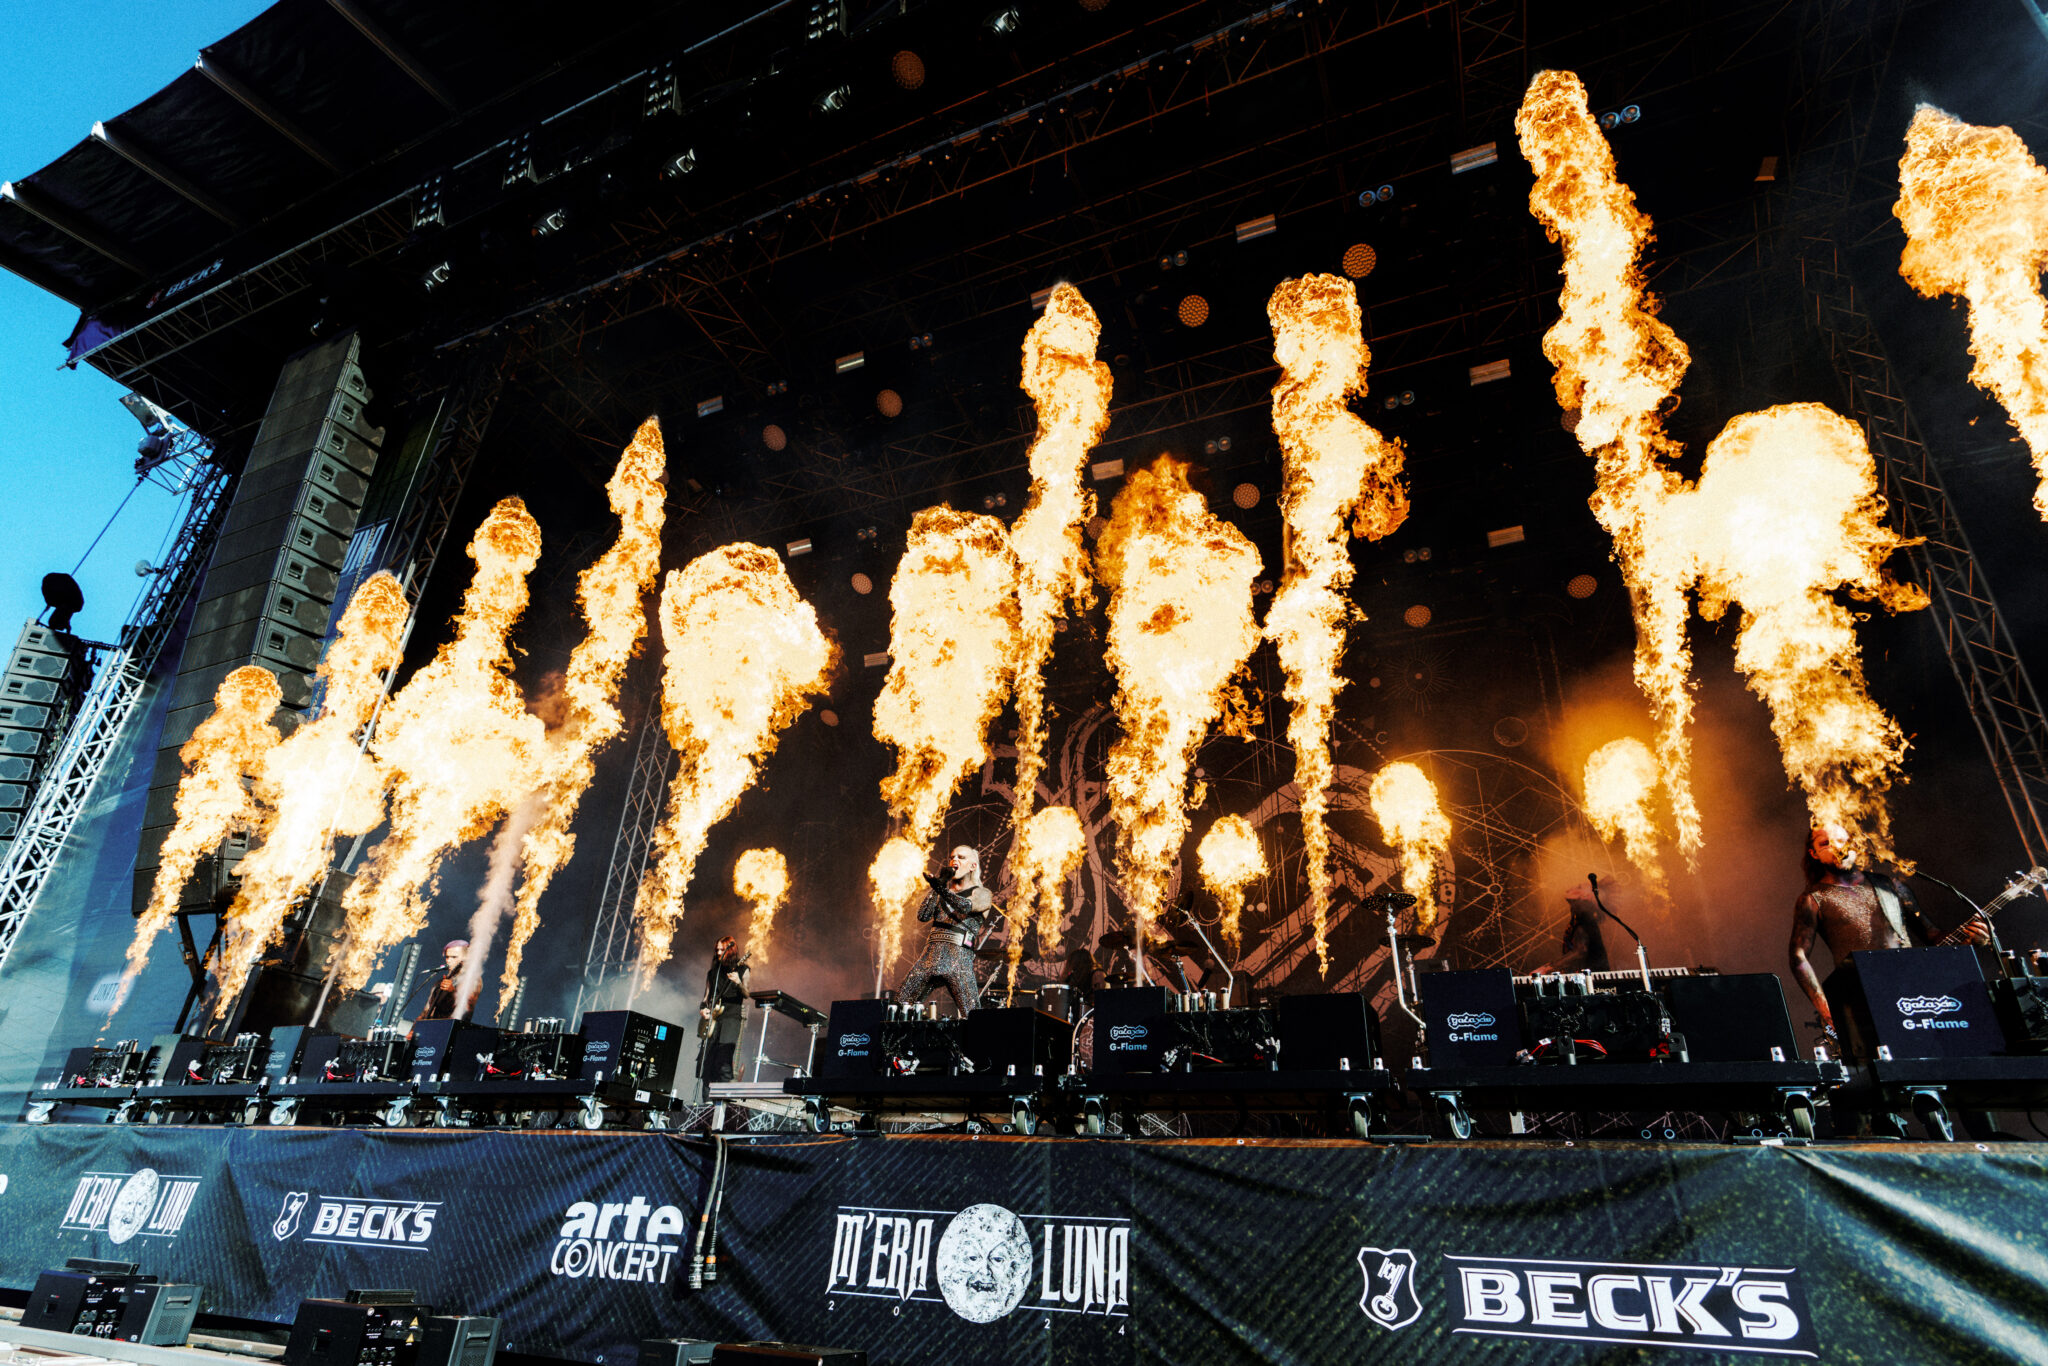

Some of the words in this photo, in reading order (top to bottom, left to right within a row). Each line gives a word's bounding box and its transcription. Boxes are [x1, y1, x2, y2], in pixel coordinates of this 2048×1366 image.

[340, 522, 389, 575] UNA
[1449, 1032, 1498, 1042] G-Flame
[1902, 1018, 1969, 1029] G-Flame
[838, 1049, 869, 1057] G-Flame
[1109, 1043, 1148, 1051] G-Flame
[148, 1181, 200, 1236] LUNA
[311, 1202, 437, 1242] BECK'S
[560, 1196, 684, 1242] arte
[550, 1238, 679, 1284] CONCERT
[825, 1212, 935, 1302] M'ERA
[1040, 1224, 1130, 1316] LUNA
[1458, 1267, 1800, 1341] BECK'S
